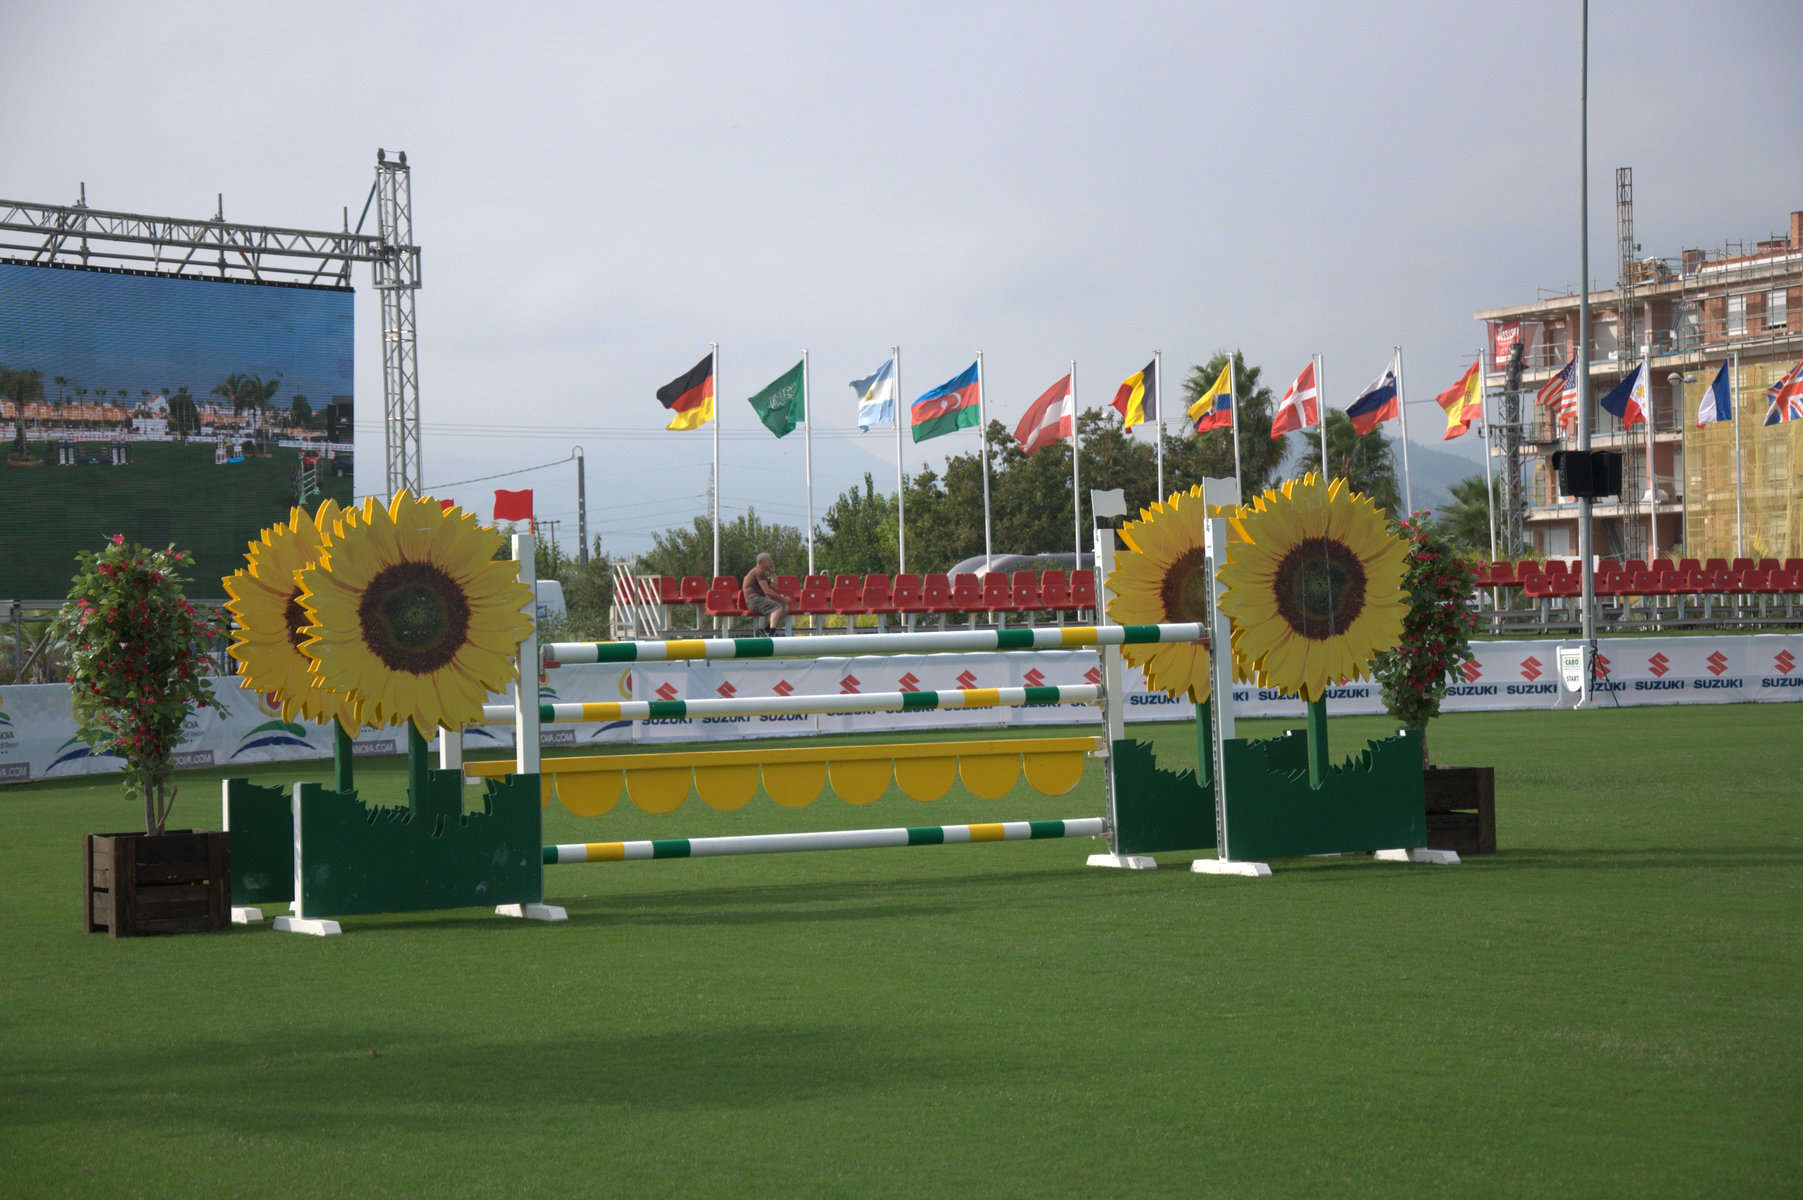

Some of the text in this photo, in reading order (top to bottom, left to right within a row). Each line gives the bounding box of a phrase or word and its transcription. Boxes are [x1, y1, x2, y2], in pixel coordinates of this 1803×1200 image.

[1506, 683, 1558, 695] SUZUKI
[1634, 680, 1685, 691] SUZUKI
[1693, 678, 1743, 689] SUZUKI
[1447, 685, 1498, 696] SUZUKI
[1130, 694, 1180, 706] SUZUKI
[702, 713, 751, 724] SUZUKI
[759, 711, 808, 722] SUZUKI
